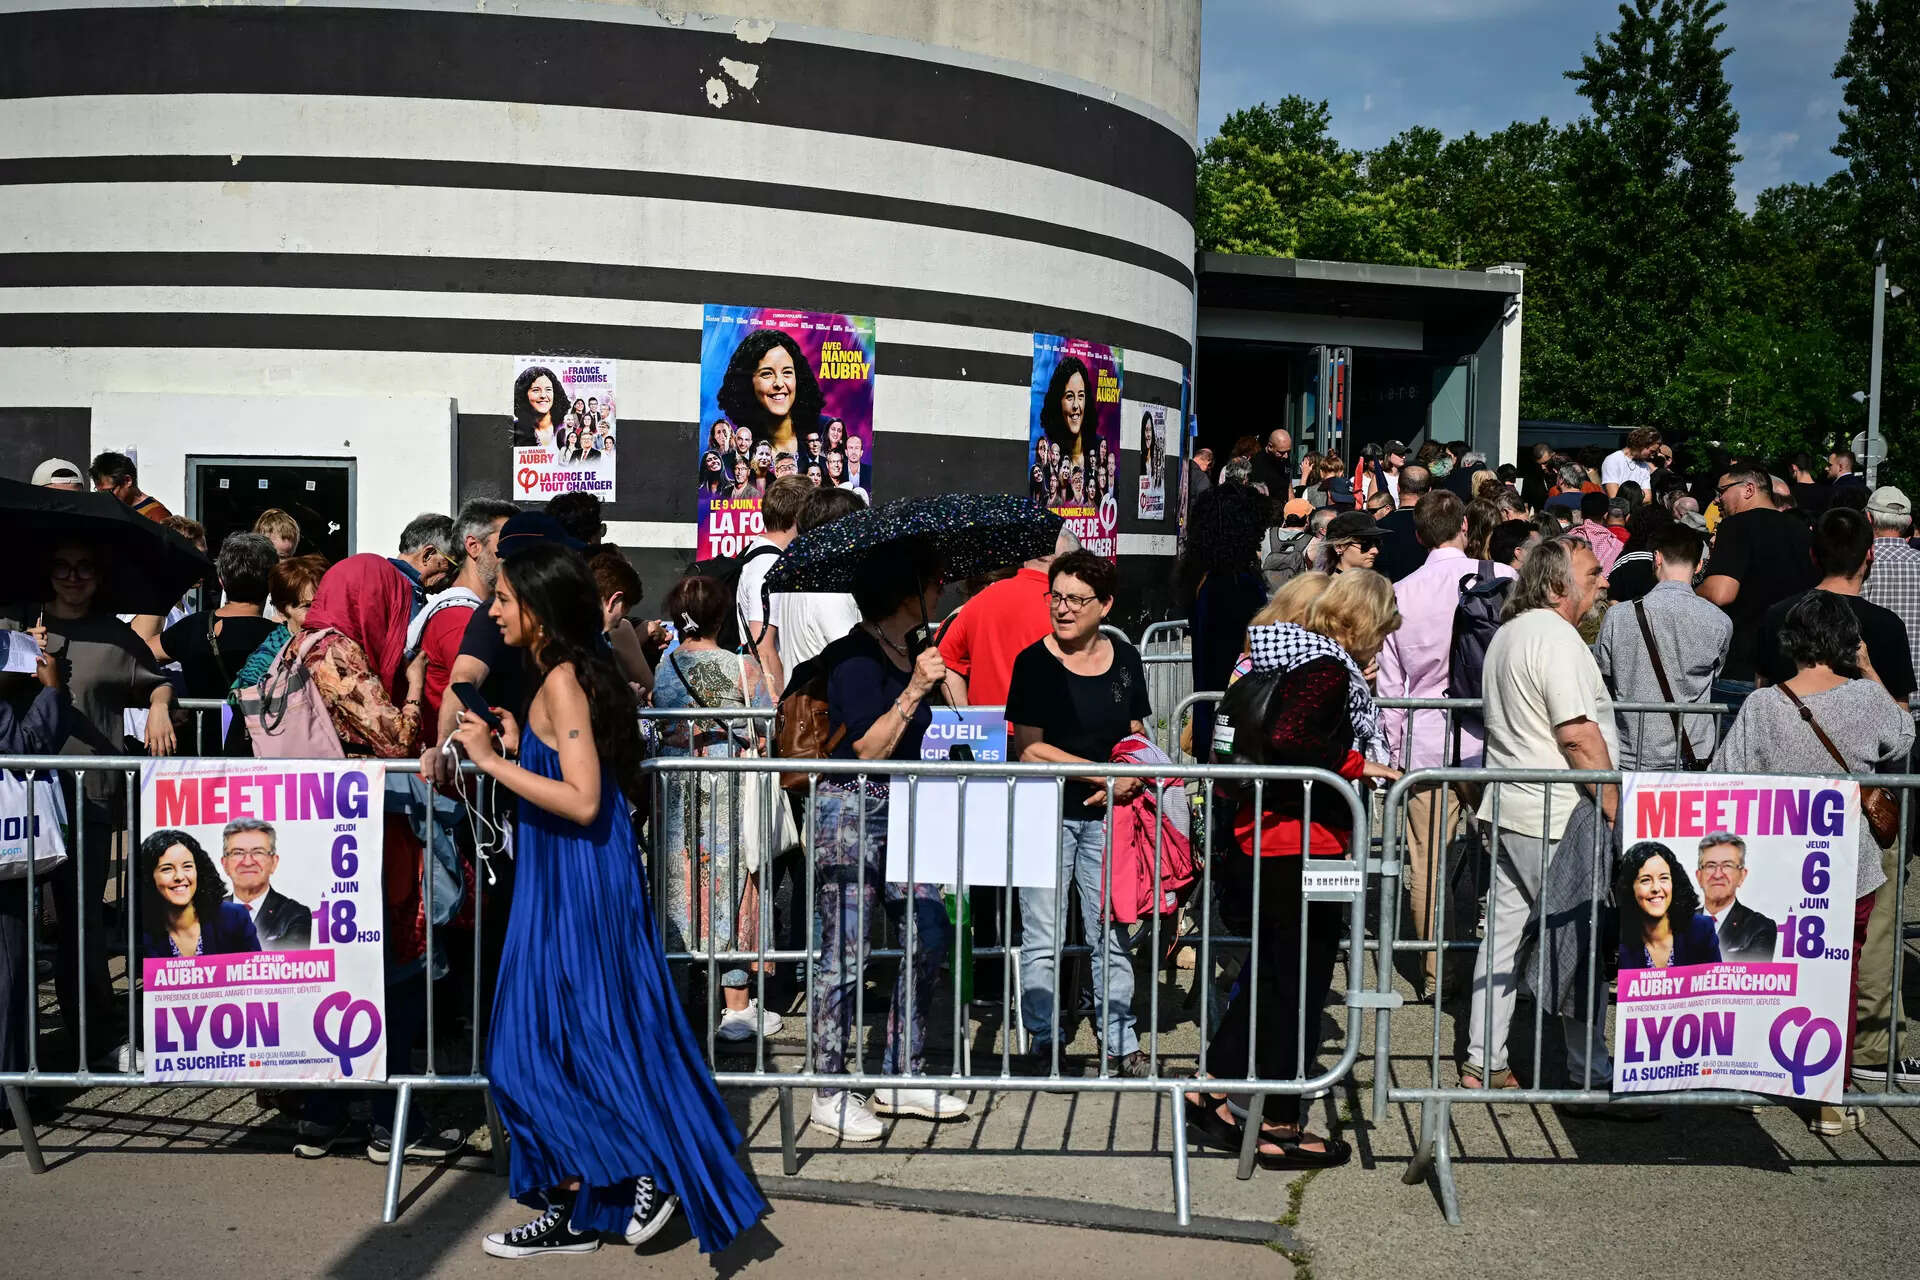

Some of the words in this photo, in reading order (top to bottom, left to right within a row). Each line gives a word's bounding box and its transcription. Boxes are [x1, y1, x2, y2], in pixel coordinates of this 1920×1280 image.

[822, 342, 841, 350] AVEC
[821, 350, 862, 363] MANON
[568, 366, 600, 374] FRANCE
[819, 362, 870, 380] AUBRY
[563, 374, 608, 383] INSOUMISE
[1096, 388, 1120, 402] AUBRY
[519, 454, 554, 464] AUBRY
[540, 472, 550, 482] LA
[552, 472, 582, 482] FORCE
[584, 471, 596, 480] DE
[540, 482, 564, 492] TOUT
[566, 480, 612, 492] CHANGER
[710, 500, 721, 510] LE
[722, 500, 729, 510] 9
[730, 498, 756, 511] JUIN,
[710, 512, 735, 534] LA
[739, 512, 768, 534] FO
[1087, 518, 1100, 538] DE
[924, 724, 988, 740] CUEIL
[156, 772, 368, 827] MEETING
[1636, 789, 1844, 839] MEETING
[333, 824, 356, 832] JEUDI
[1805, 840, 1830, 849] JEUDI
[331, 834, 358, 878] 6
[1802, 852, 1830, 896] 6
[1304, 876, 1313, 886] la
[331, 882, 358, 894] JUIN
[1799, 898, 1829, 910] JUIN
[166, 960, 196, 968] MANON
[252, 954, 285, 963] JEAN-LUC
[154, 966, 217, 987] AUBRY
[226, 958, 330, 982] MÉLENCHON
[1640, 970, 1666, 979] MANON
[1712, 966, 1747, 974] JEAN-LUC
[1628, 977, 1684, 998] AUBRY
[1690, 972, 1790, 993] MÉLENCHON
[154, 994, 164, 1002] EN
[164, 992, 192, 1002] PRÉSENCE
[200, 991, 223, 1000] GABRIEL
[1634, 1004, 1660, 1012] PRÉSENCE
[1668, 1002, 1687, 1010] GABRIEL
[1704, 999, 1711, 1007] ET
[1756, 998, 1781, 1006] DÉPUTÉS
[154, 1002, 280, 1053] LYON
[1624, 1012, 1736, 1064] LYON
[155, 1057, 175, 1072] LA
[177, 1053, 246, 1070] SUCRIÈRE
[278, 1058, 298, 1066] RÉGION
[1622, 1068, 1638, 1082] LA
[1640, 1062, 1699, 1080] SUCRIÈRE
[1712, 1066, 1728, 1074] HÔTEL
[1729, 1068, 1749, 1076] RÉGION
